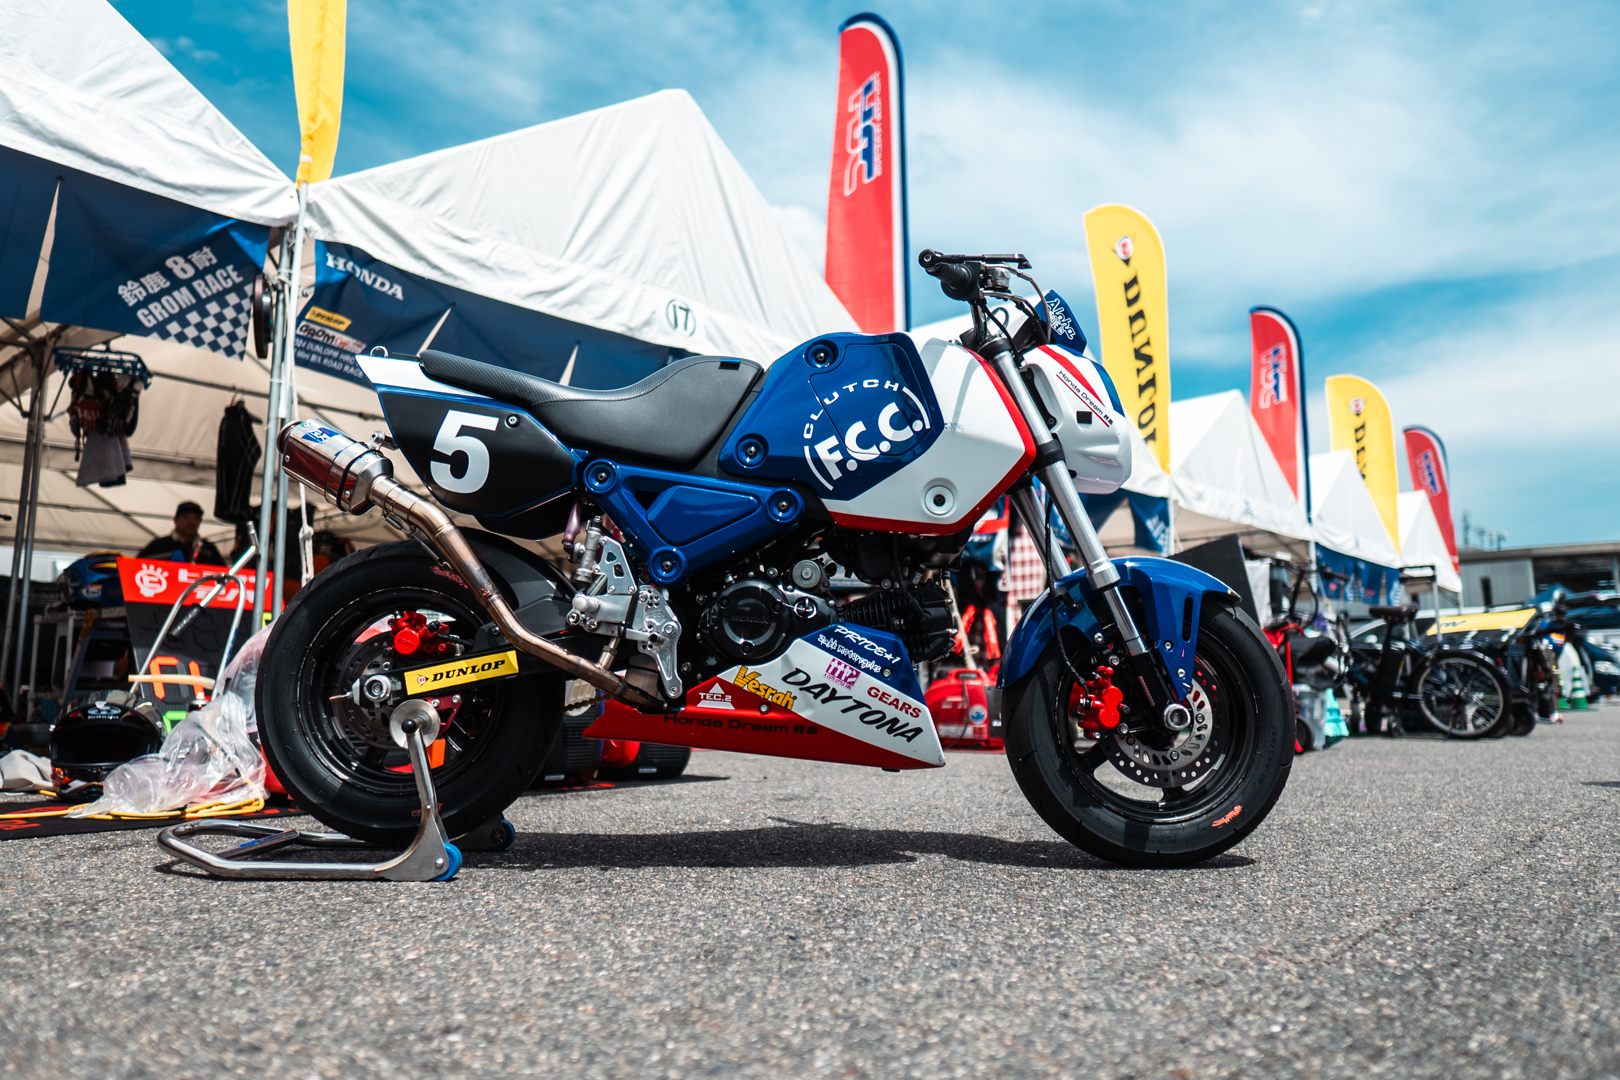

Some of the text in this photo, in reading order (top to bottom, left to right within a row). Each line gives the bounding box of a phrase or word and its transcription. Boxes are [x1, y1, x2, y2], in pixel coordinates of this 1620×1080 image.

[136, 264, 243, 328] GROM RACE
[326, 252, 404, 301] HONDA
[300, 324, 335, 345] GROM
[1046, 298, 1076, 340] Aloha
[803, 379, 900, 439] CLUTCH
[1059, 370, 1081, 393] Honda
[1081, 392, 1103, 415] Dream
[430, 409, 499, 494] 5
[431, 660, 506, 682] DUNLOP
[733, 665, 796, 711] Vesrah
[699, 692, 732, 702] TEC.2
[781, 667, 924, 743] DAYTONA
[867, 686, 921, 719] GEARS
[664, 714, 723, 728] Honda
[728, 719, 788, 733] Dream
